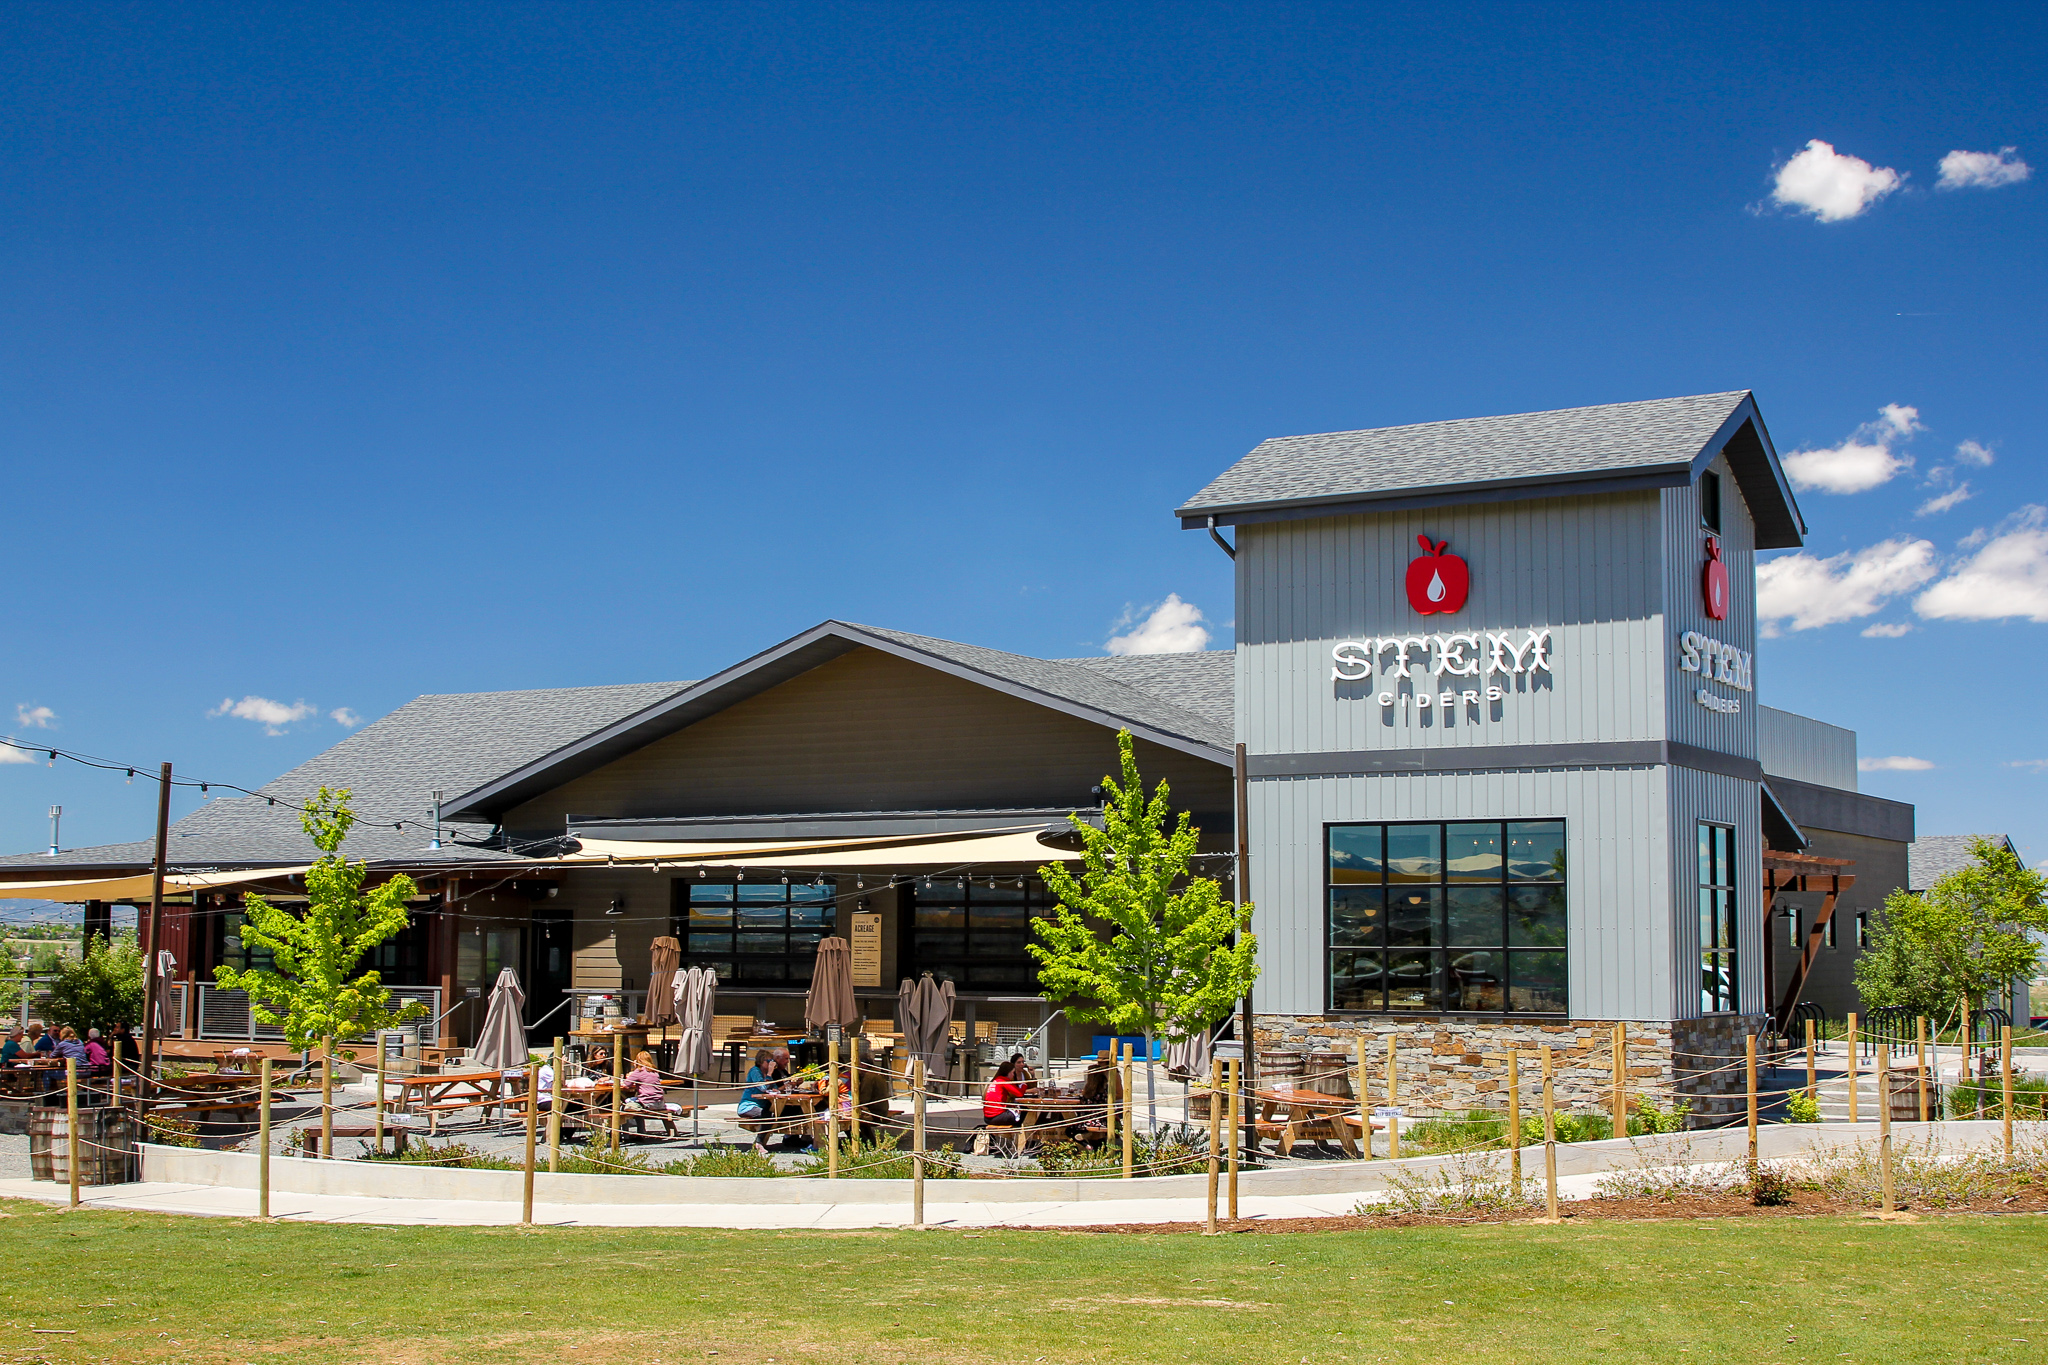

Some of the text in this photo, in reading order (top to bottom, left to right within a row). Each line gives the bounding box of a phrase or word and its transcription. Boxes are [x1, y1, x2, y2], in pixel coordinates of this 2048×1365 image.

[1330, 629, 1552, 682] STEM
[1681, 630, 1752, 692] STEM
[1377, 686, 1502, 708] CIDERS
[1696, 689, 1740, 713] CIDERS
[854, 925, 875, 933] ACREAGE
